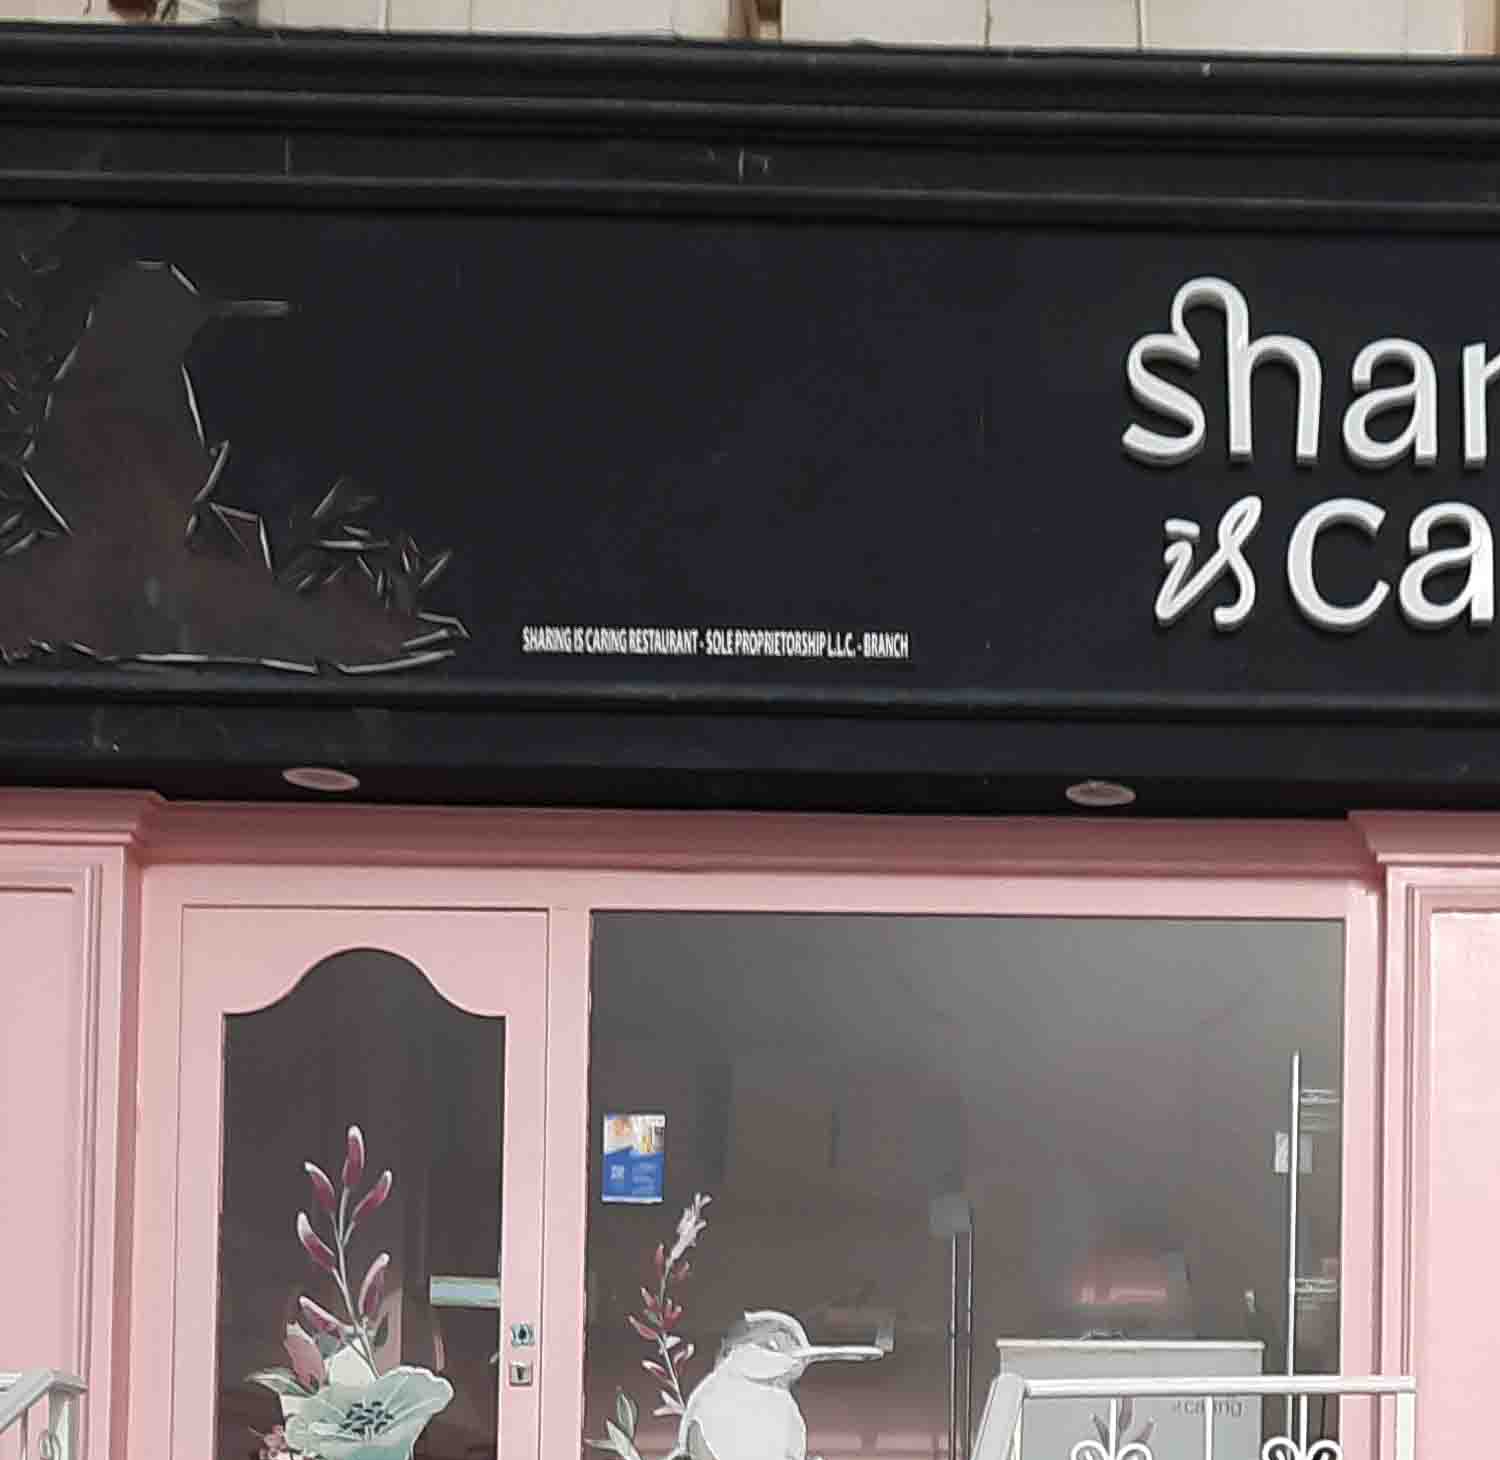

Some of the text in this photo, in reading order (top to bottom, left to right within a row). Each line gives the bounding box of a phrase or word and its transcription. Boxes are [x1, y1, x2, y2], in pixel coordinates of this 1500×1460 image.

[1153, 495, 1263, 630] is
[522, 625, 572, 653] SHARING
[573, 626, 584, 653] IS
[584, 626, 627, 654] CARING
[628, 627, 699, 655] RESTAURANT
[705, 628, 734, 656] SOLE
[734, 629, 826, 657] PROPRIETORSHIP
[863, 631, 909, 659] BRANCH
